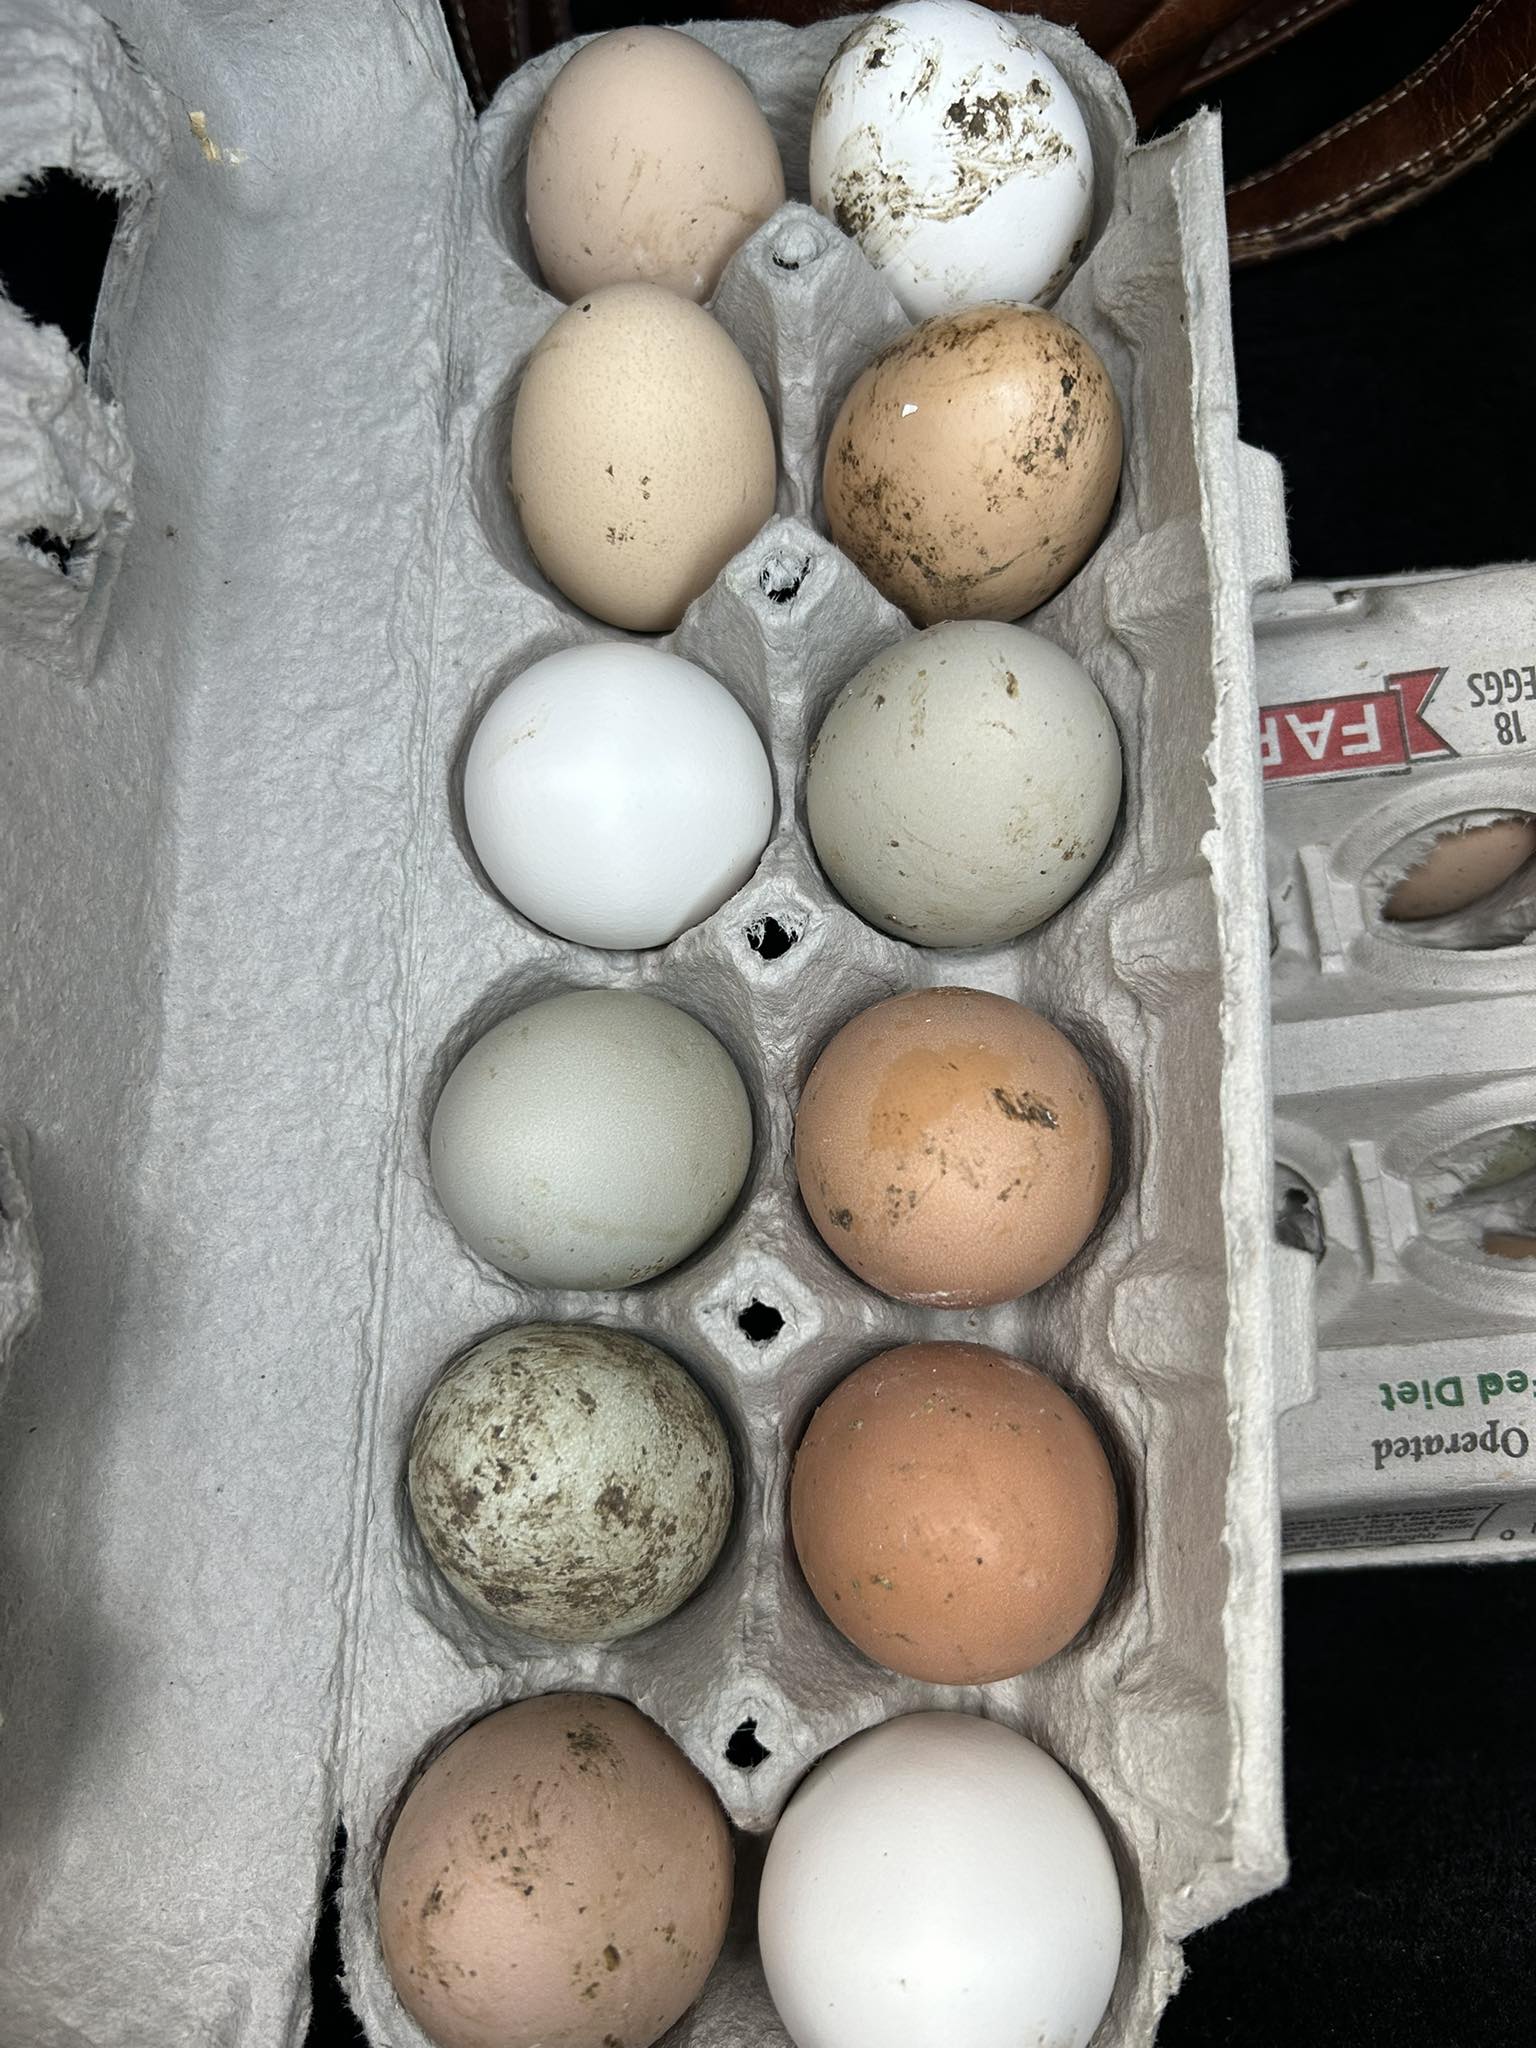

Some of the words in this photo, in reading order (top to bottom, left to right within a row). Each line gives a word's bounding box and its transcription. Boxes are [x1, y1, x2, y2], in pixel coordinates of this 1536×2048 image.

[1467, 666, 1536, 708] EGGS
[1494, 710, 1527, 745] 18
[1378, 1376, 1464, 1411] Diet
[1477, 1370, 1536, 1405] ed
[1371, 1419, 1529, 1471] Operated
